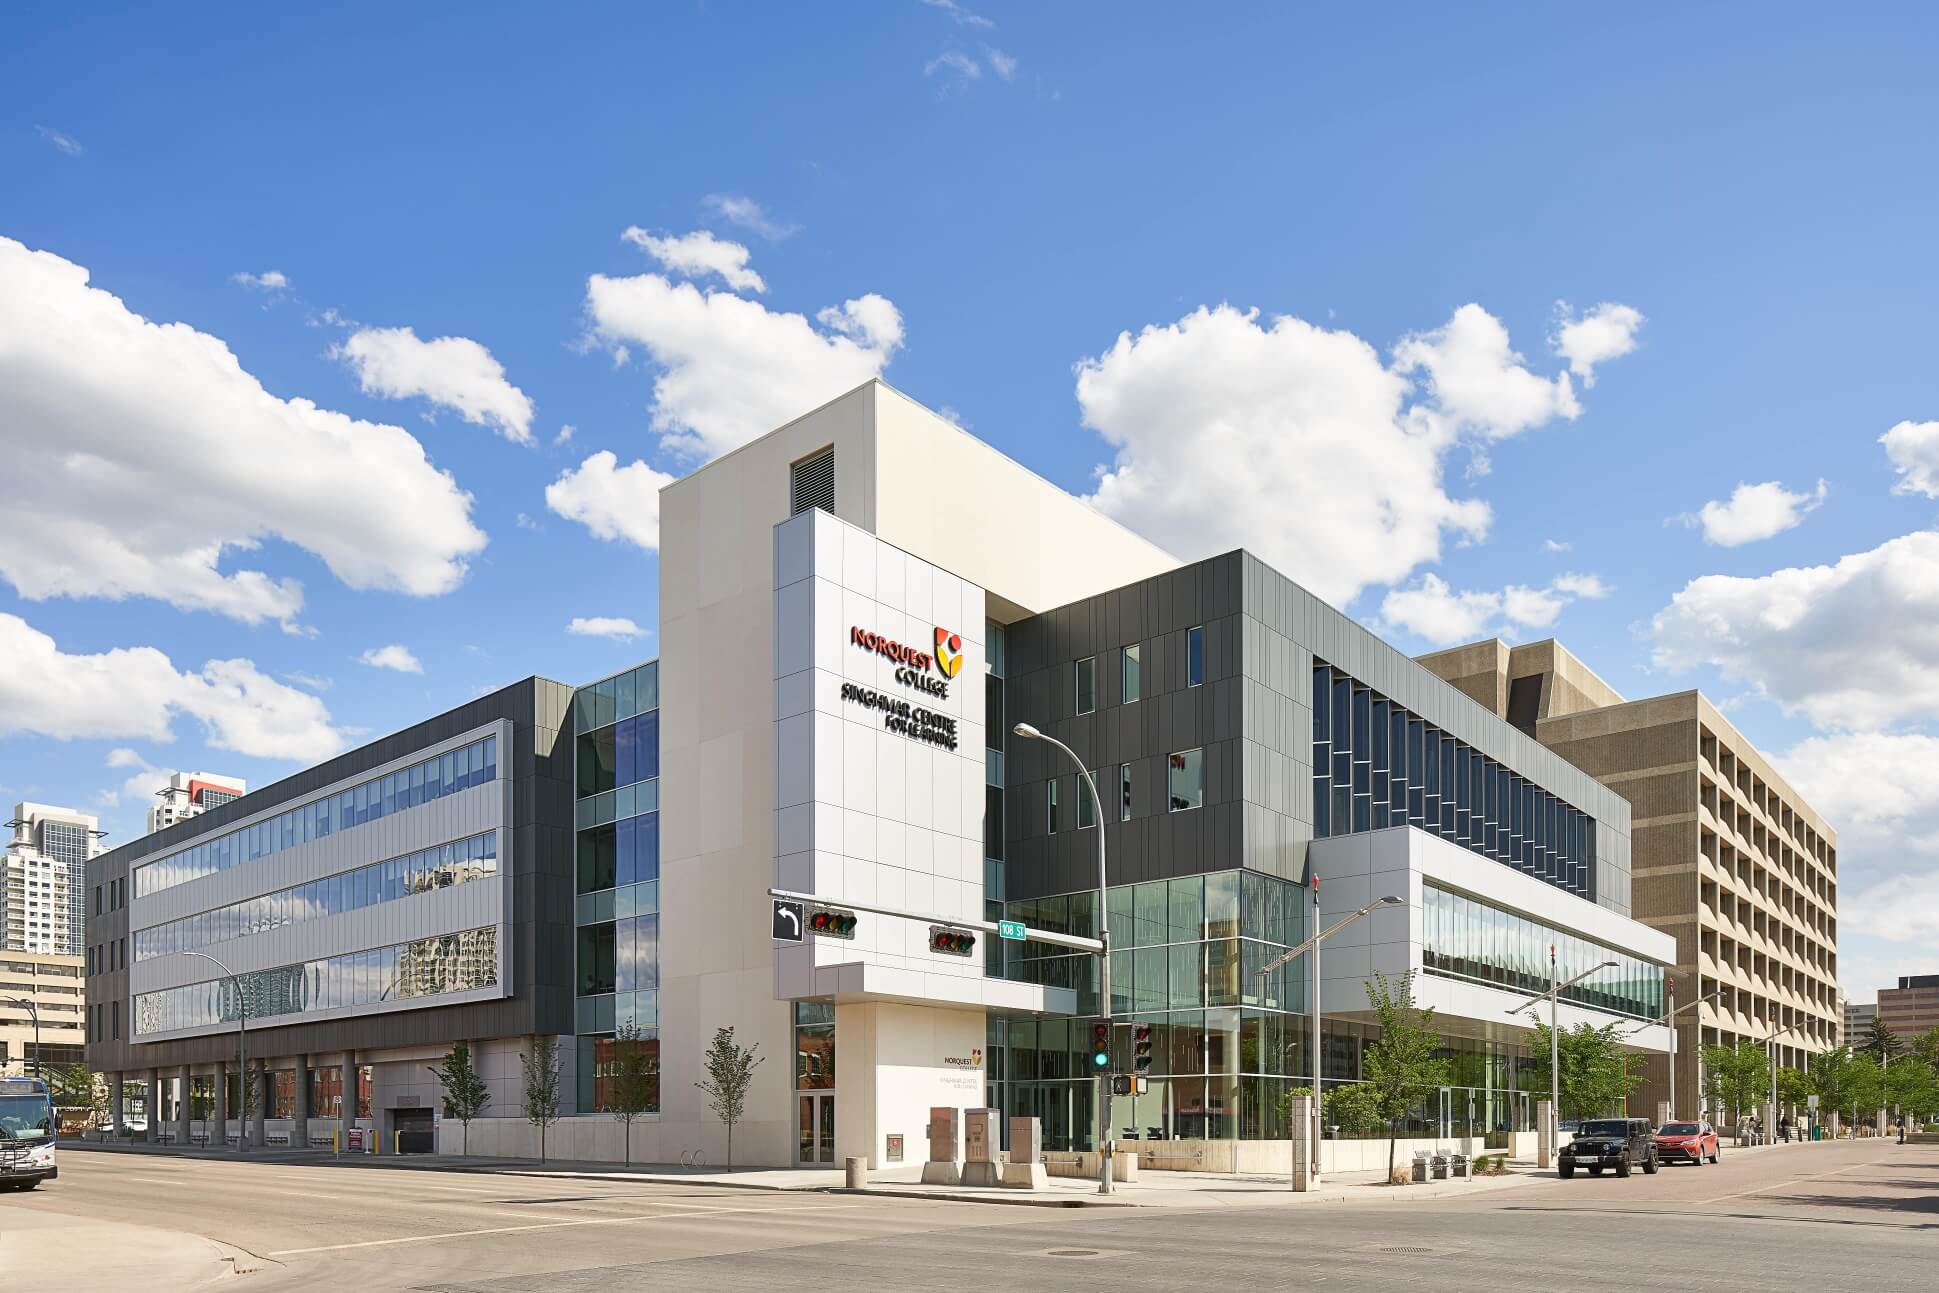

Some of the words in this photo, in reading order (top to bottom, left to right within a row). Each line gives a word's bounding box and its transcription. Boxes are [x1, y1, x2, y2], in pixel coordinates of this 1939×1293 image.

[851, 625, 933, 673] NORQUEST
[895, 667, 949, 700] COLLEGE
[841, 682, 911, 718] SINGHMAR
[911, 707, 957, 735] CENTRE
[885, 714, 907, 736] FOR
[907, 723, 958, 751] LEARNING
[1002, 923, 1014, 936] 108
[1016, 926, 1024, 937] ST
[944, 1057, 972, 1066] NORQUEST
